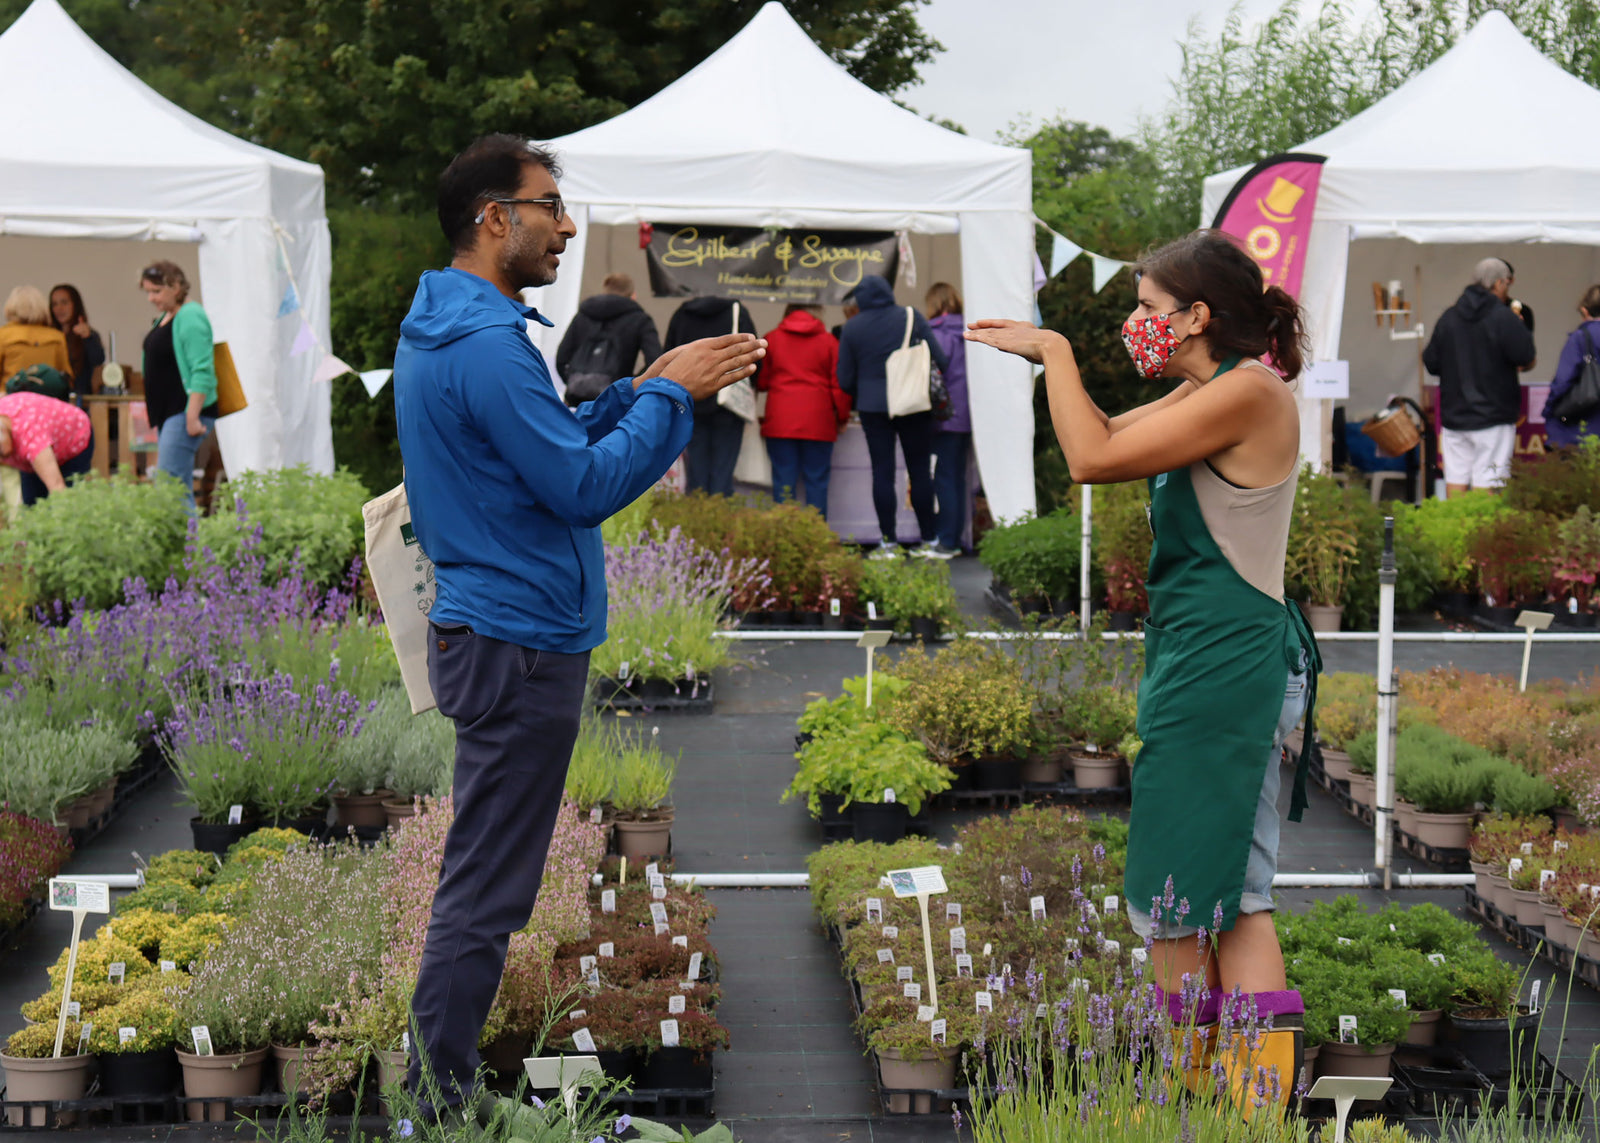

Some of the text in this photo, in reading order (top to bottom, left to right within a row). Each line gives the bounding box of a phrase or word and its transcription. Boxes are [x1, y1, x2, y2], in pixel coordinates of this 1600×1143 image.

[661, 226, 884, 287] Gilbert & Swayne
